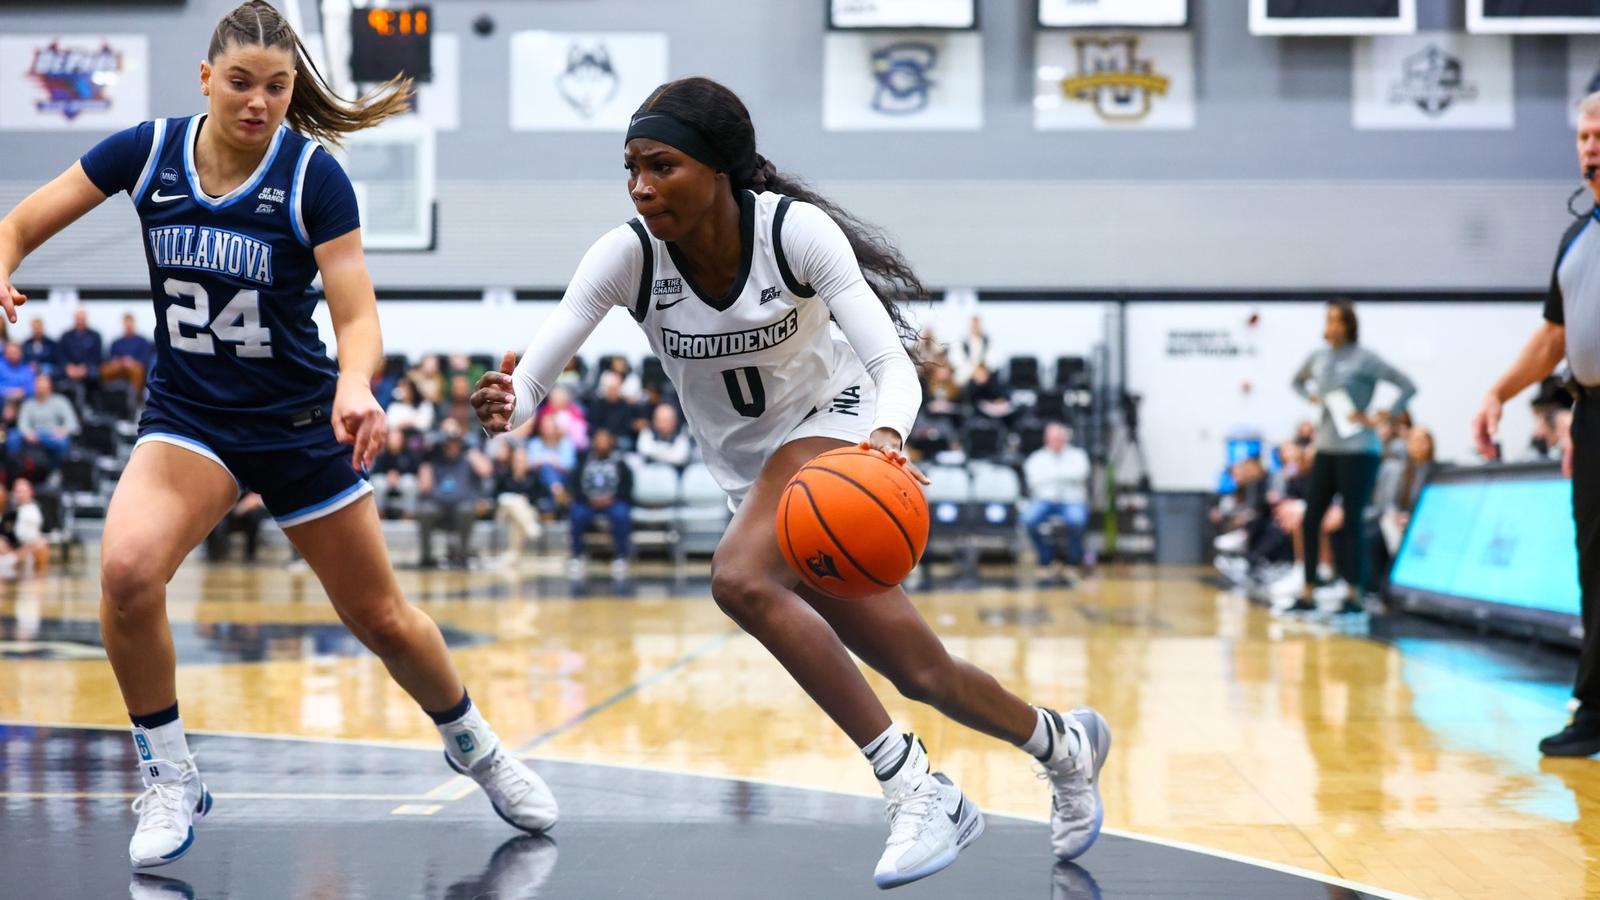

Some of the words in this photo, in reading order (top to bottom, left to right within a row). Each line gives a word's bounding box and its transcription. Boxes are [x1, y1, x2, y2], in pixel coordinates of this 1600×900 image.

[273, 188, 286, 197] THE
[258, 193, 286, 203] CHANGE
[149, 225, 273, 285] VILLANOVA
[656, 279, 666, 287] BE
[667, 278, 681, 286] THE
[653, 285, 682, 295] CHANGE
[163, 277, 273, 358] 24
[661, 308, 798, 359] PROVIDENCE
